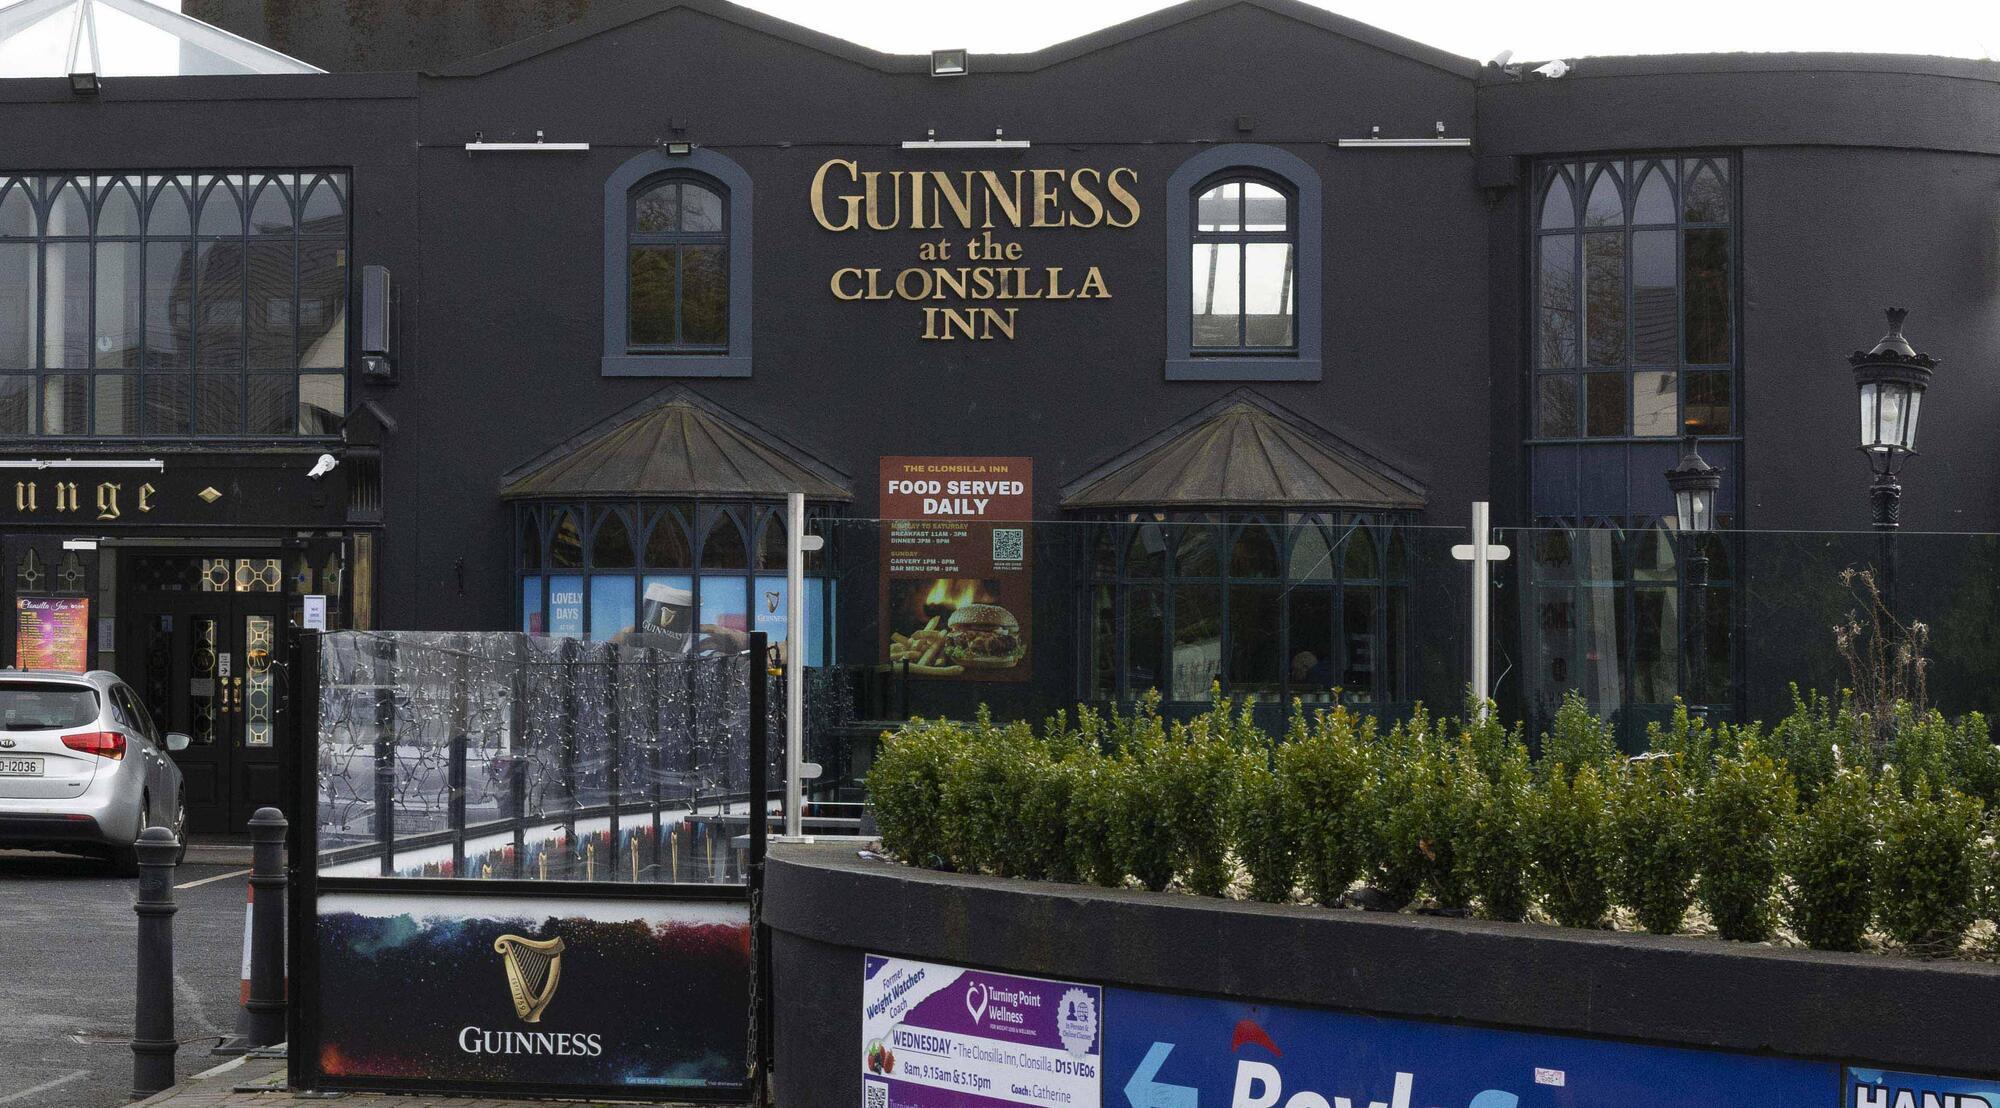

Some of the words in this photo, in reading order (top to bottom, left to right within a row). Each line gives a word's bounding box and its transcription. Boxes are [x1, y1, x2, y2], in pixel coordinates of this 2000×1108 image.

[810, 158, 1141, 231] GUINNESS
[919, 238, 951, 261] at
[968, 232, 1023, 261] the
[830, 266, 1112, 301] CLONSILLA
[921, 307, 1019, 340] INN
[904, 465, 925, 473] THE
[928, 465, 986, 473] CLONSILLA
[989, 465, 1009, 473] INN
[888, 480, 941, 495] FOOD
[947, 480, 1024, 495] SERVED
[923, 498, 989, 515] DAILY
[552, 592, 583, 605] LOVELY
[556, 607, 579, 620] DAYS
[883, 968, 903, 990] Former
[514, 992, 527, 1011] 1759
[866, 991, 893, 1020] Weight
[891, 968, 925, 1000] Watchers
[988, 986, 1018, 1007] Turning
[1019, 991, 1041, 1007] Point
[889, 998, 908, 1019] Coach
[988, 1005, 1024, 1024] Wellness
[458, 1026, 602, 1057] GUINNESS
[893, 1029, 952, 1055] WEDNESDAY
[958, 1043, 971, 1059] The
[972, 1045, 1003, 1064] Clonsilla
[1004, 1050, 1019, 1068] Inn,
[1020, 1053, 1054, 1073] Clonsilla,
[1055, 1058, 1072, 1075] D15
[1073, 1061, 1095, 1079] VE06
[904, 1061, 923, 1079] 8am,
[923, 1064, 952, 1083] 9.15am
[953, 1069, 960, 1085] &
[961, 1072, 992, 1091] 5.15pm
[1032, 1084, 1071, 1103] Catherine
